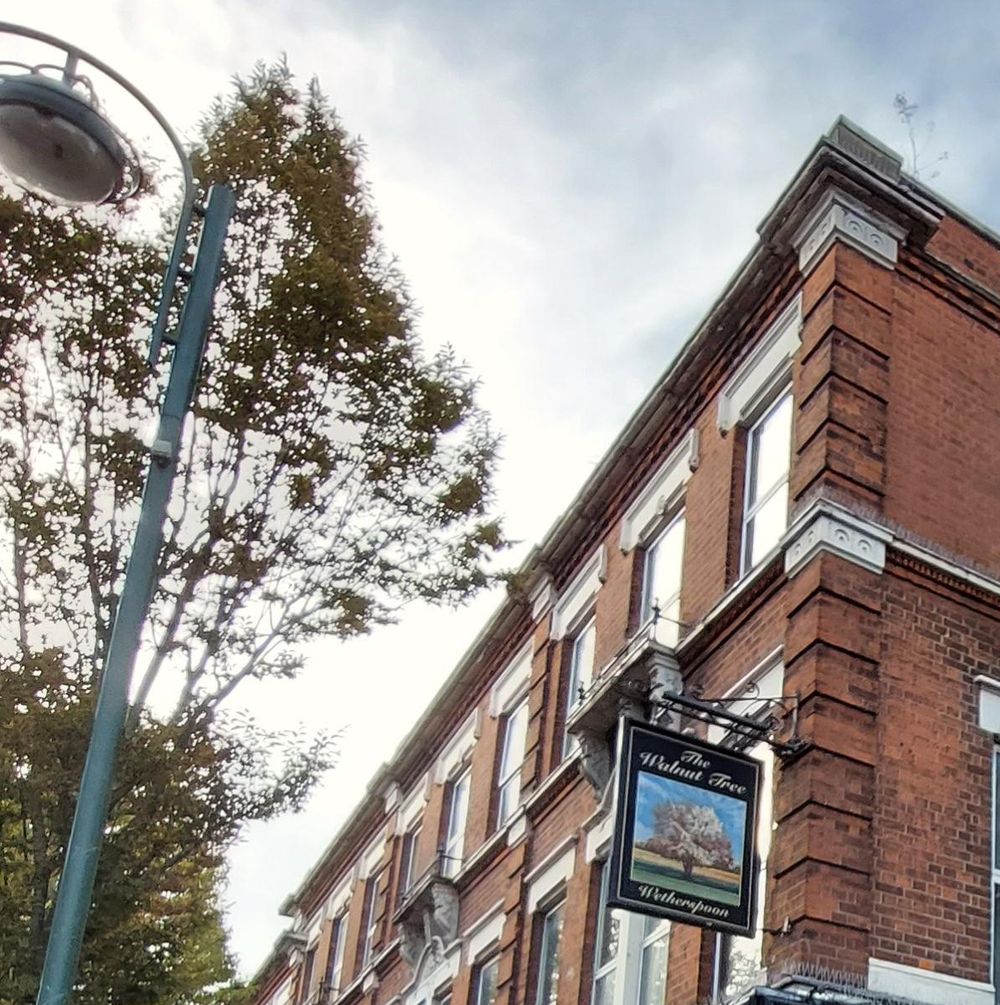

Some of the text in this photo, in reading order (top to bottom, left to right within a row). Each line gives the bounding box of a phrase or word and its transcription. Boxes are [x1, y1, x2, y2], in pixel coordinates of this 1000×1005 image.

[639, 752, 748, 795] Walnut Tree
[680, 749, 711, 769] The
[637, 883, 730, 918] Wetherspoon
